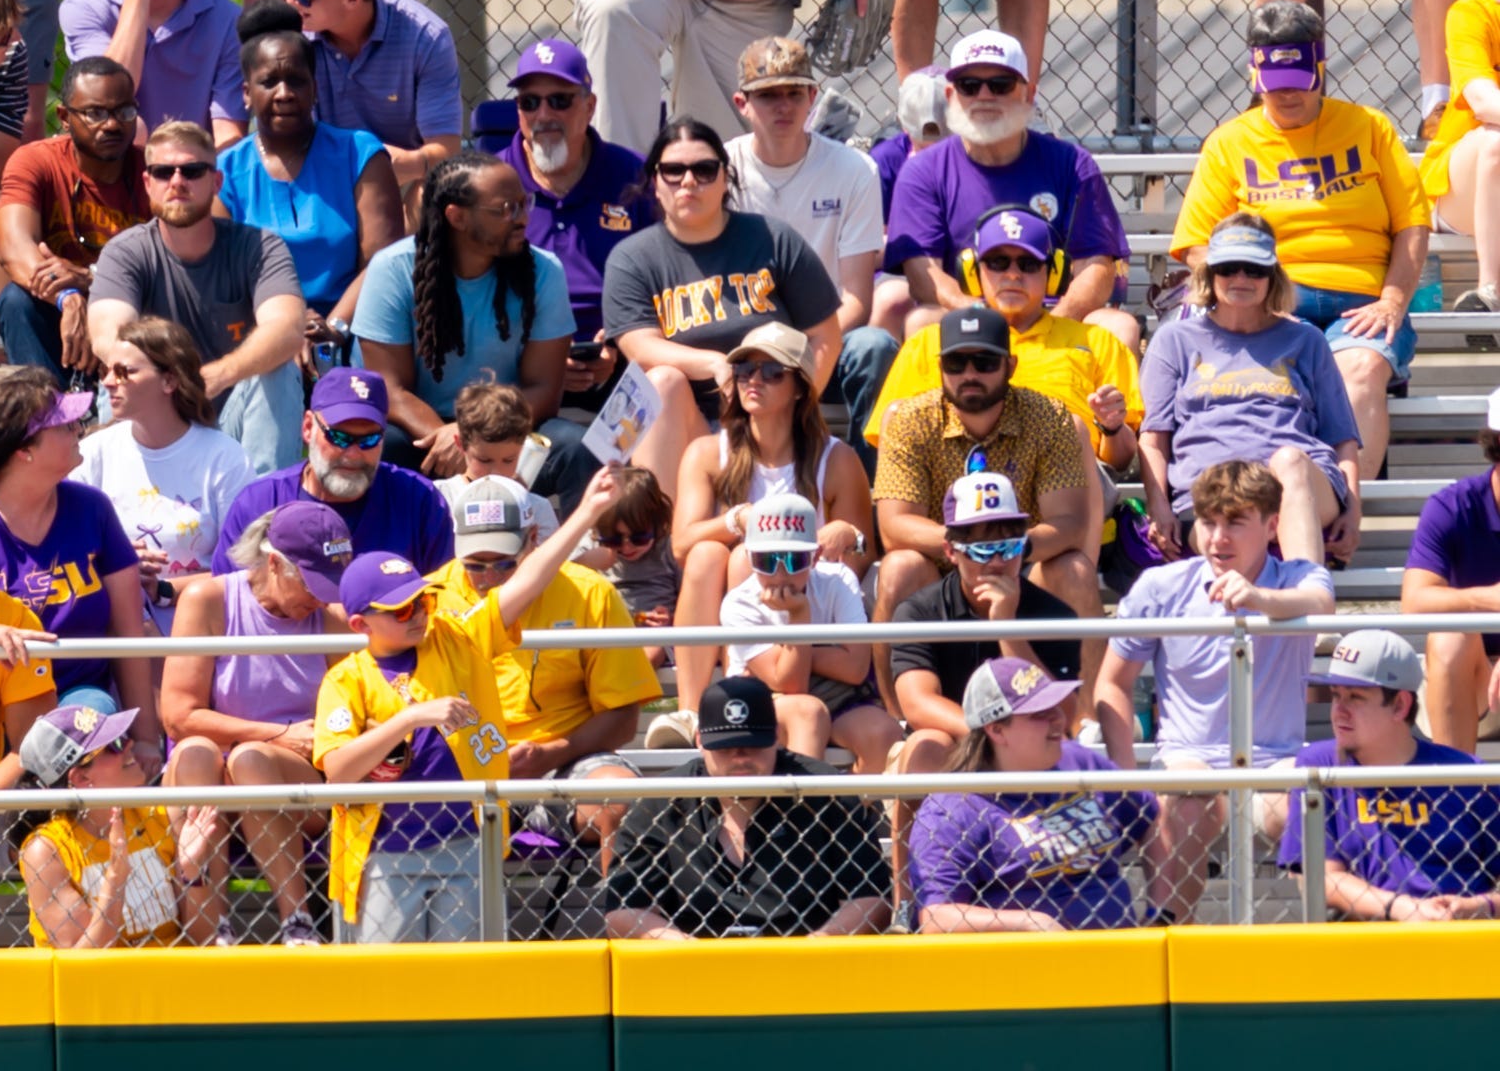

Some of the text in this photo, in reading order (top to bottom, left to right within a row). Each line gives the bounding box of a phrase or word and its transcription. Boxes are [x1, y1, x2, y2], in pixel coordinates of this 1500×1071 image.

[1244, 145, 1362, 190] LSU
[812, 199, 841, 211] LSU
[654, 276, 725, 339] OCKY
[1333, 646, 1360, 664] SU
[469, 723, 507, 766] 23
[1357, 798, 1430, 826] LSU
